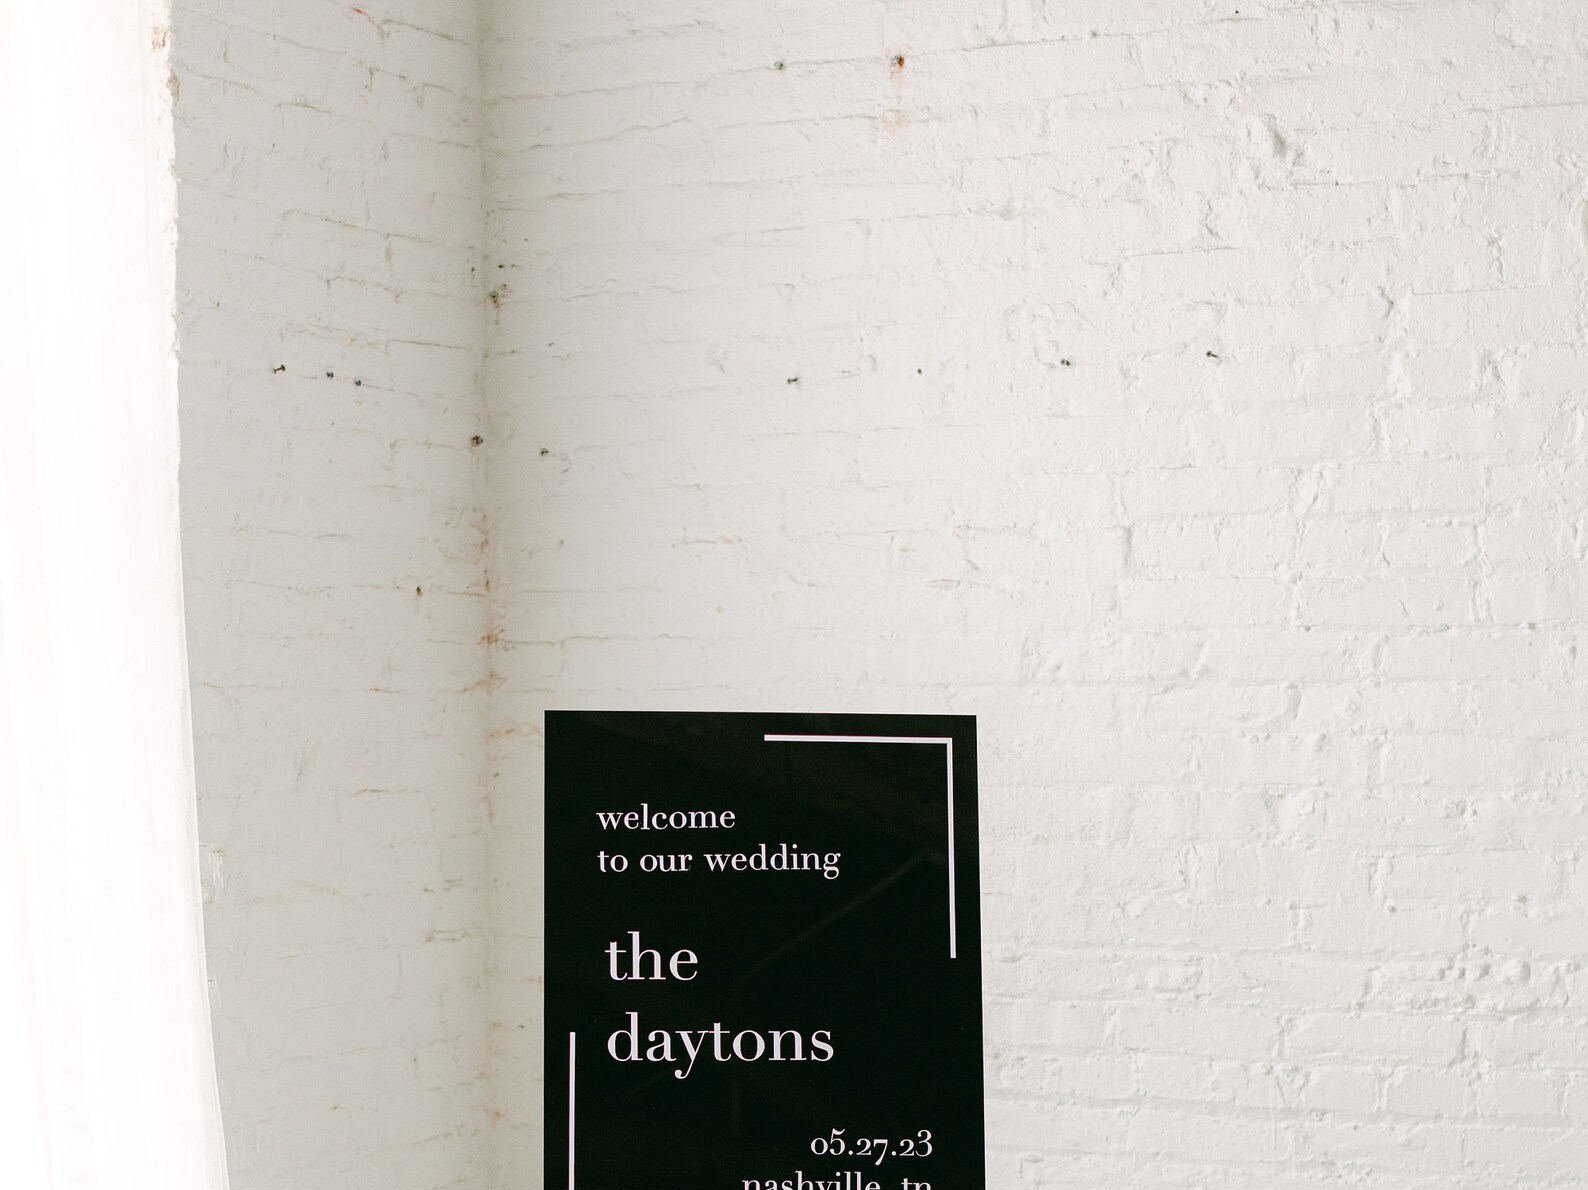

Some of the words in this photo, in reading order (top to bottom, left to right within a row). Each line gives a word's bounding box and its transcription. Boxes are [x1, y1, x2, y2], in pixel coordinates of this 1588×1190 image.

[596, 803, 736, 831] welcome
[597, 850, 629, 873] to
[639, 853, 693, 873] our
[703, 843, 842, 880] wedding
[604, 930, 700, 982] the
[606, 1011, 835, 1080] daytons
[810, 1128, 934, 1167] 05.27.23
